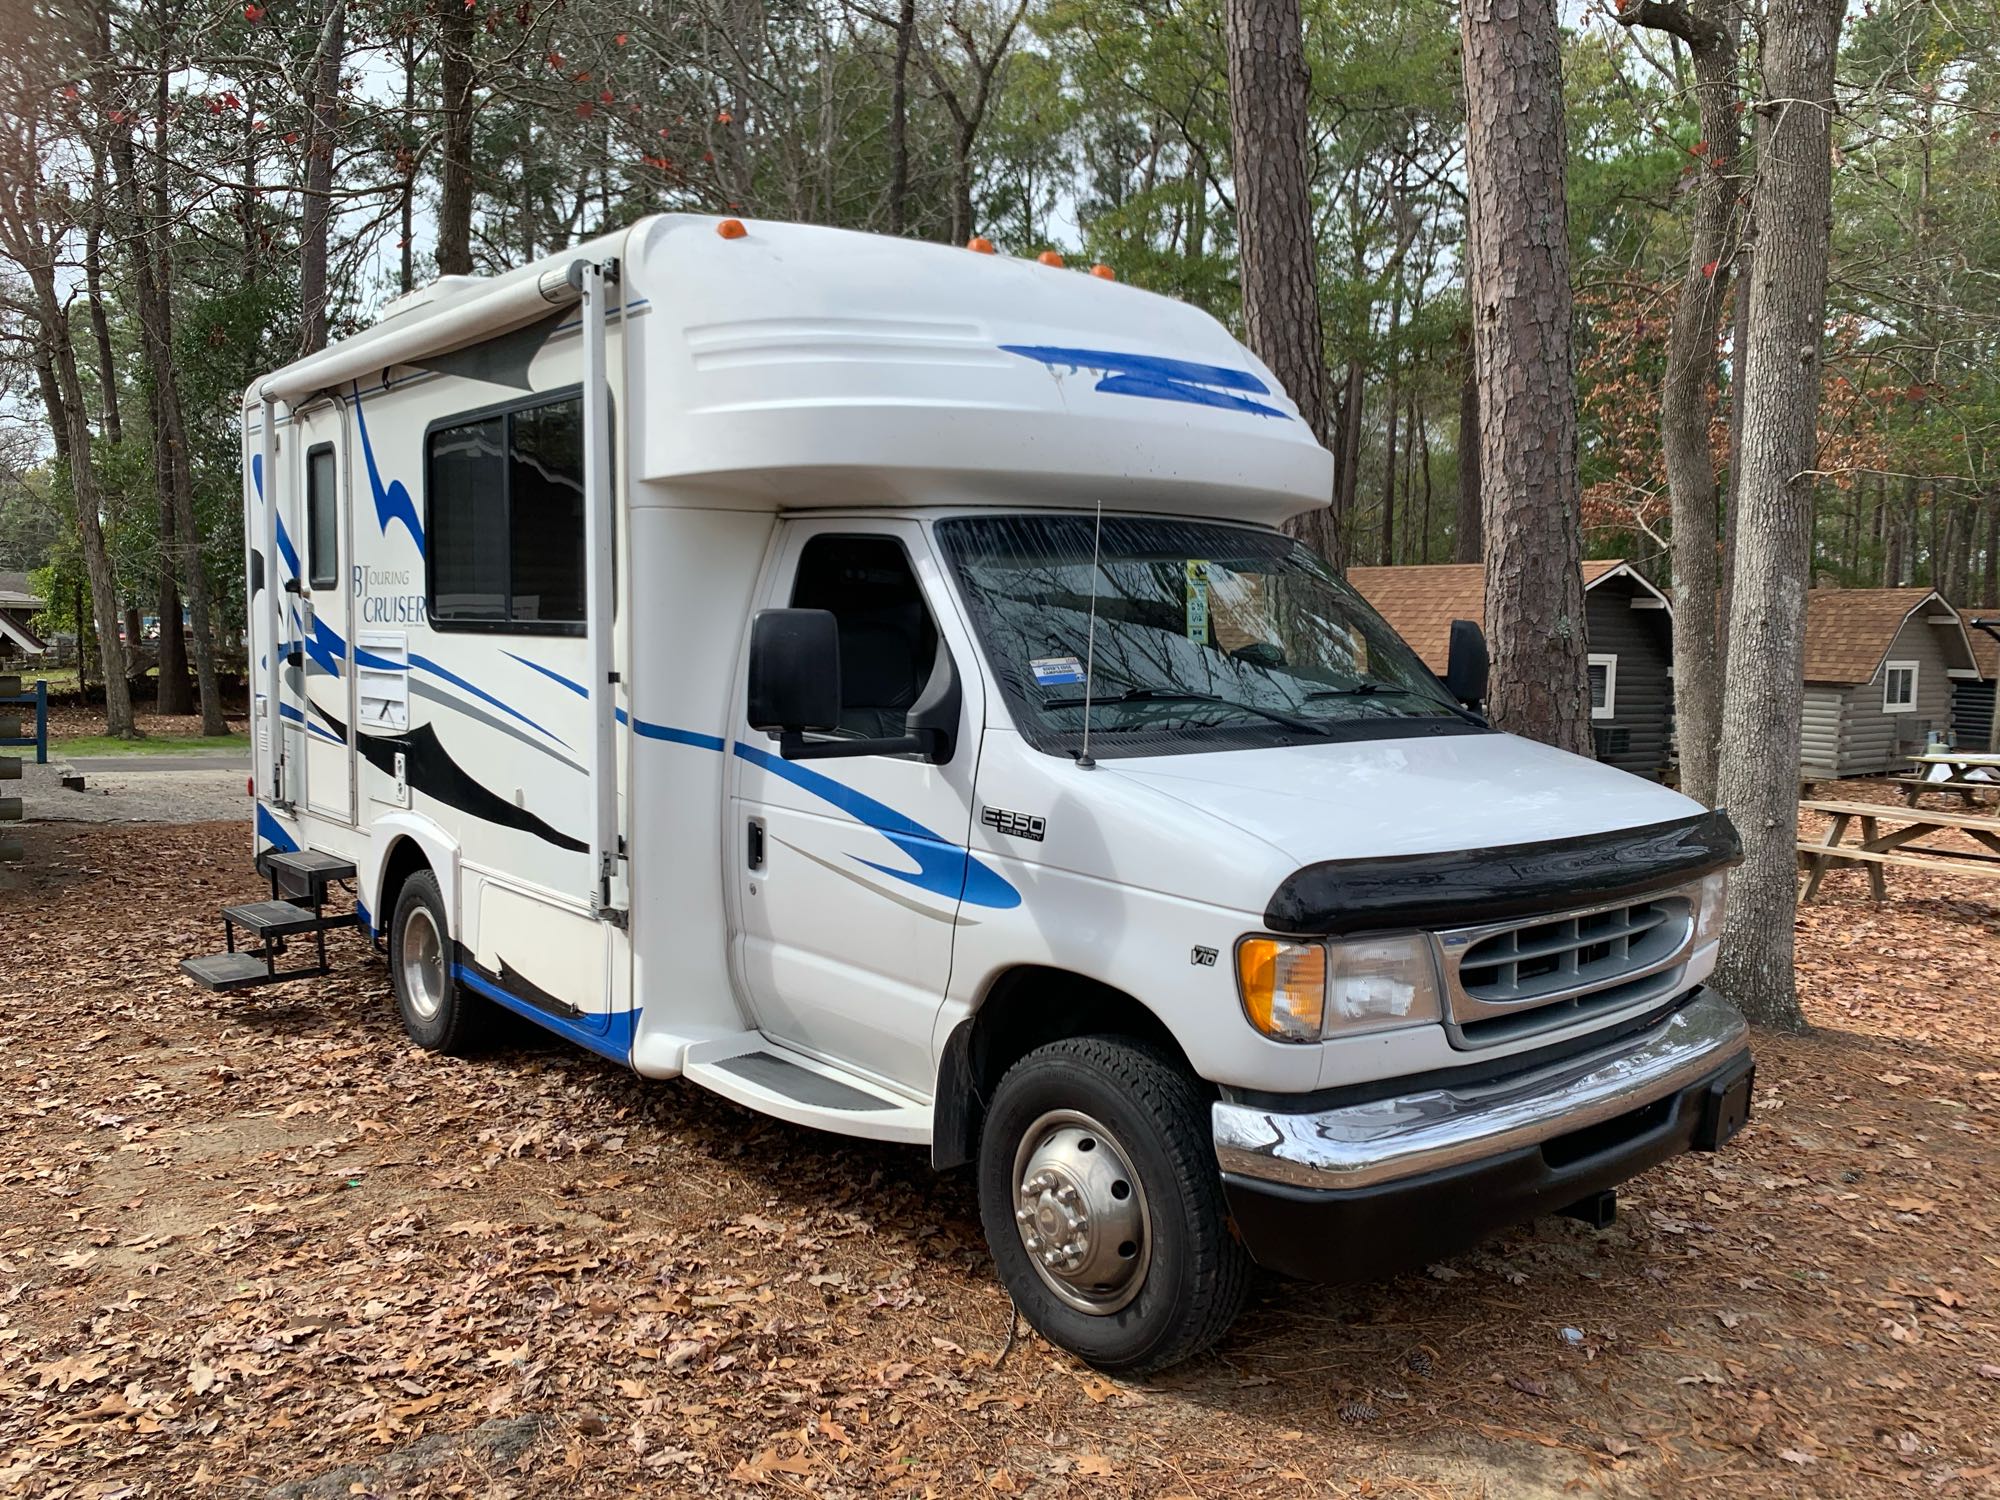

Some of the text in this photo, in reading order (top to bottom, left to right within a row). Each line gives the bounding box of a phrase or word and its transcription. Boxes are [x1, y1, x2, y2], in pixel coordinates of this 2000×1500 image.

[364, 595, 427, 622] CRUISER
[999, 826, 1042, 841] SUPER DUTY
[1191, 950, 1216, 966] V10
